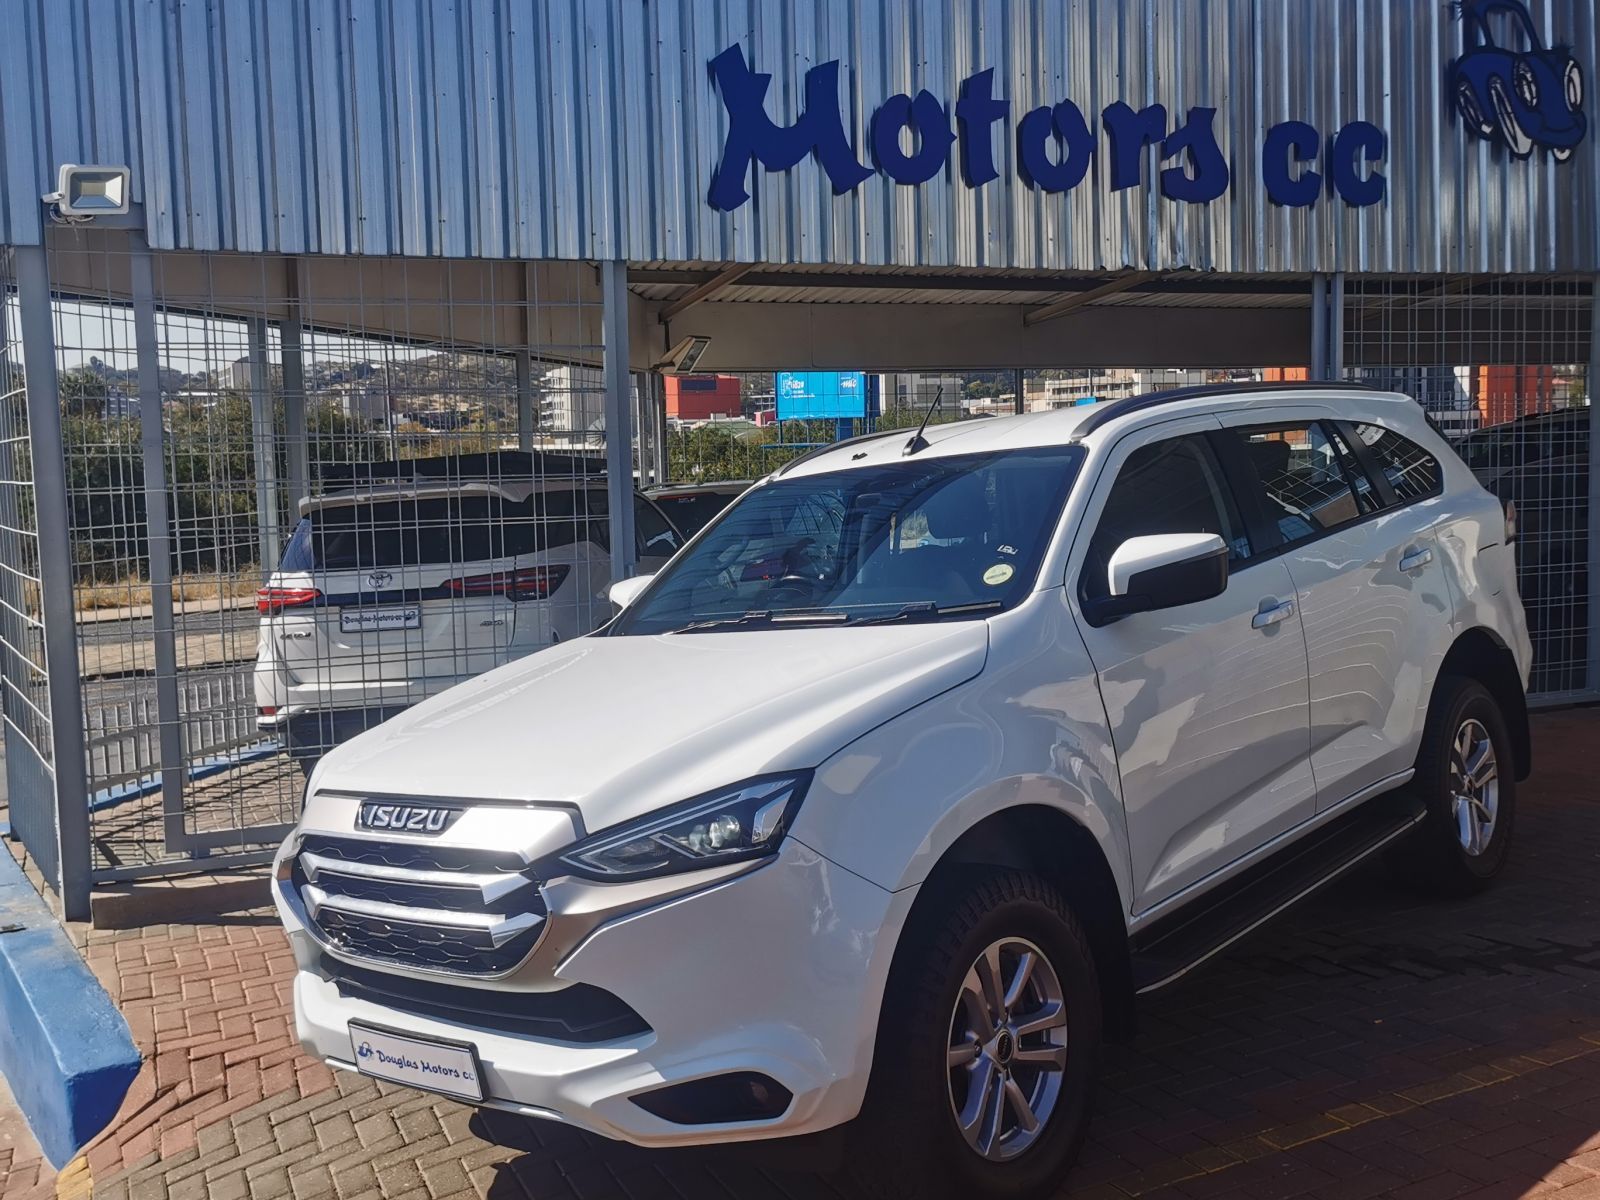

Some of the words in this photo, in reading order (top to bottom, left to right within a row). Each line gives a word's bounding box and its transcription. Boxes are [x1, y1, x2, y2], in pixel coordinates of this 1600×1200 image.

[708, 43, 1230, 212] Motors
[1263, 120, 1387, 207] cc
[366, 805, 449, 831] ISUZU
[376, 1049, 419, 1070] Douglas
[420, 1059, 460, 1078] Motors
